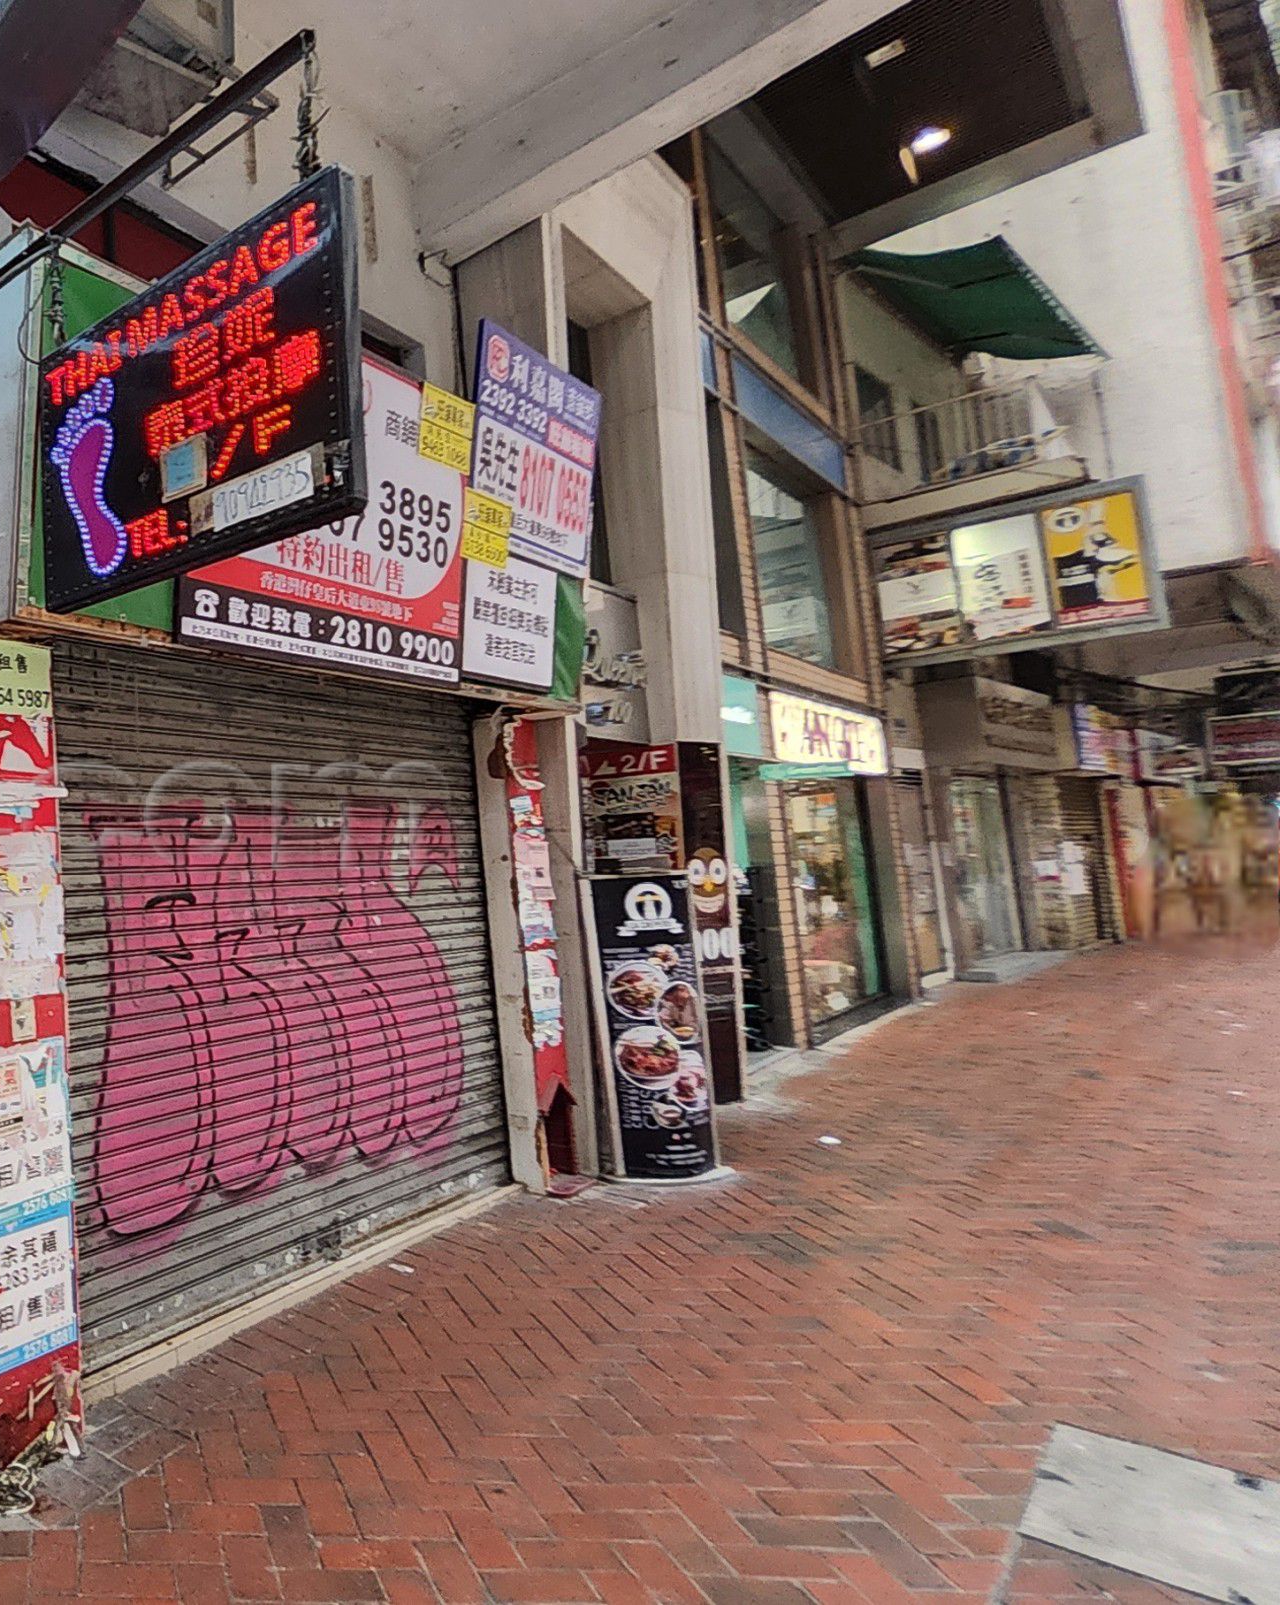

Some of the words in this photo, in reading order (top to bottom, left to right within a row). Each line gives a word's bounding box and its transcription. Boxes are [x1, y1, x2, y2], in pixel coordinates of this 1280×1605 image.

[45, 331, 122, 406] THAI
[126, 201, 319, 358] MASSAGE
[379, 480, 452, 534] 3895
[378, 517, 449, 569] 9530
[329, 615, 394, 653] 2810
[399, 631, 456, 666] 9900
[17, 688, 50, 709] 5987
[620, 749, 669, 774] 2/F
